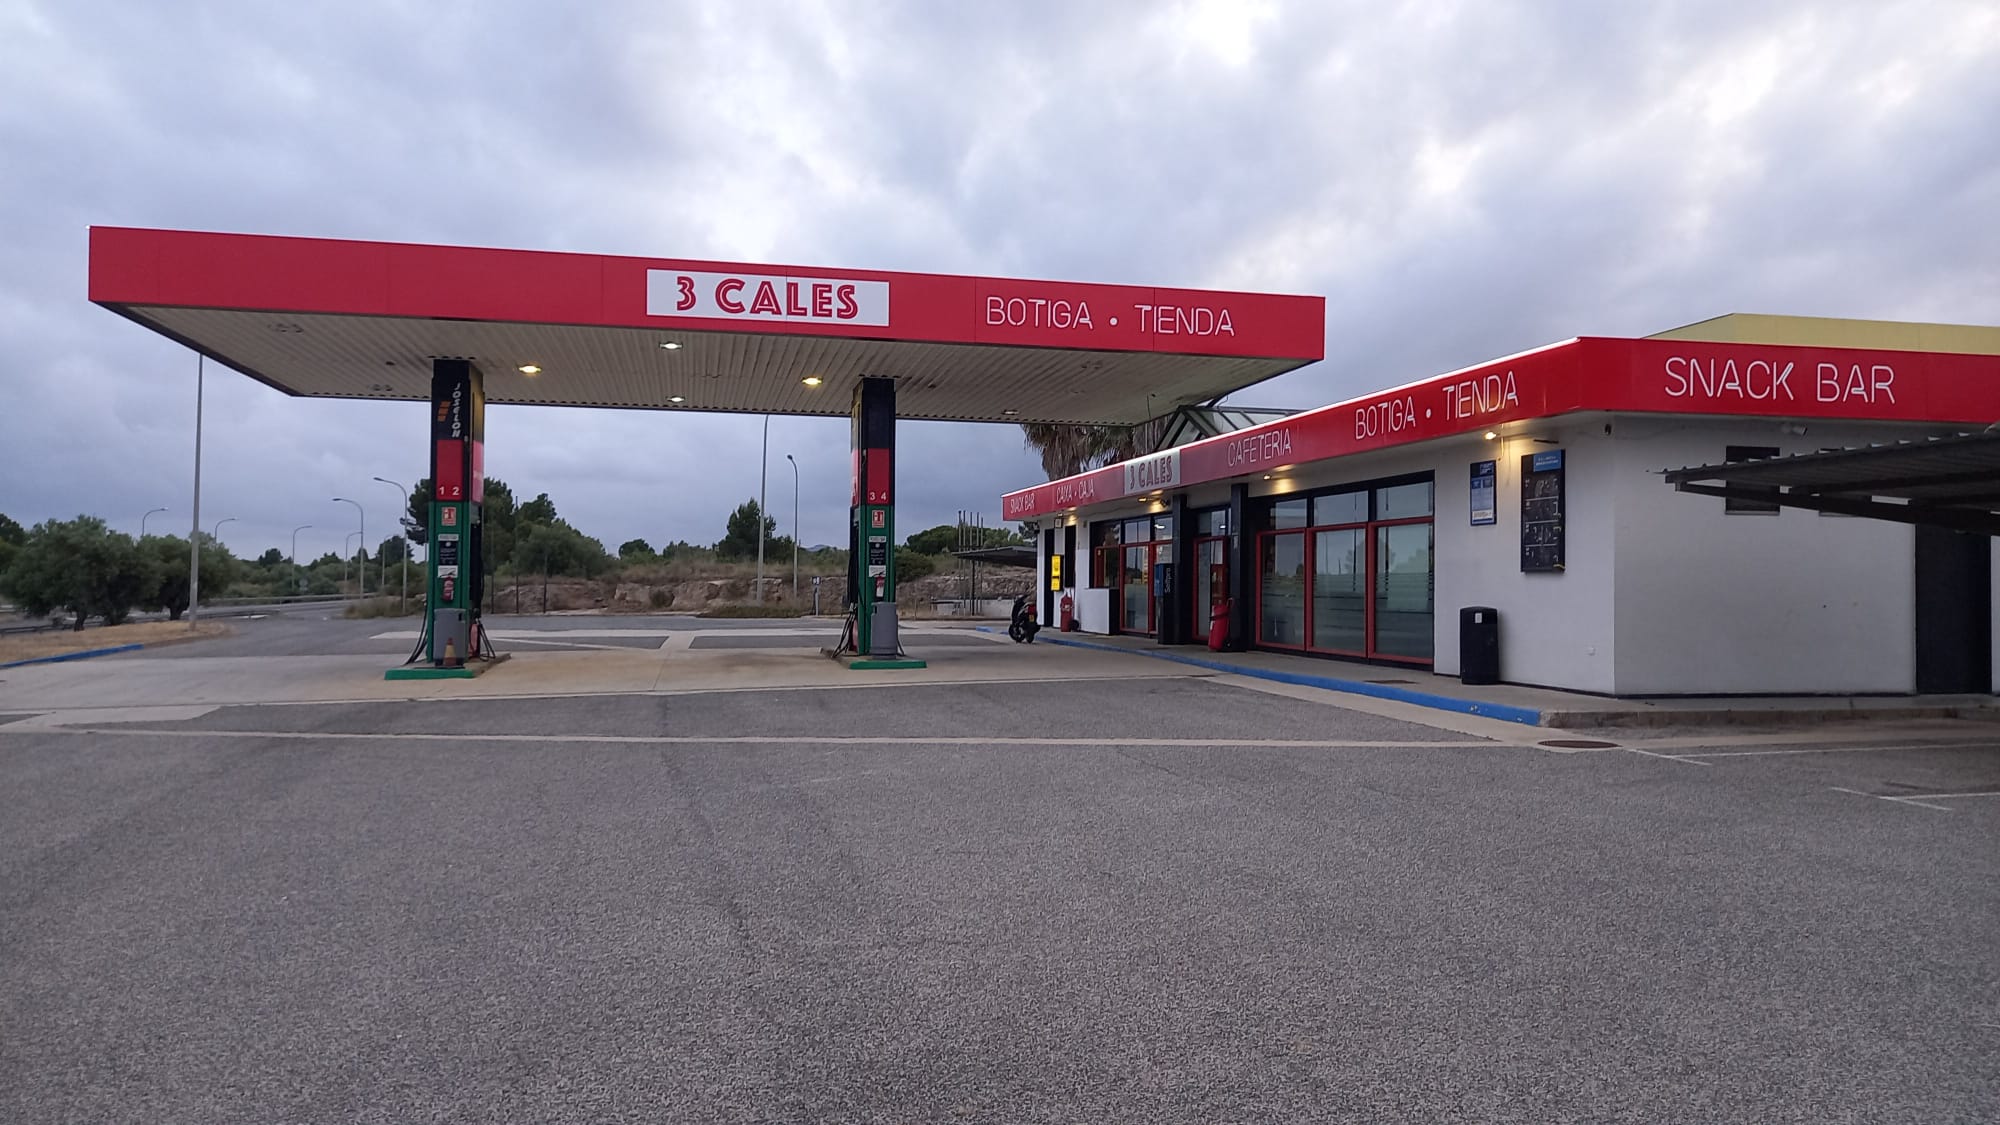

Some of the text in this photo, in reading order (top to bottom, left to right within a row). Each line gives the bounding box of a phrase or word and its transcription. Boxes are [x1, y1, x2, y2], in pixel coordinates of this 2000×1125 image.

[676, 276, 859, 319] 3 CALES
[986, 296, 1235, 336] BOTIGA TIENDA
[1665, 357, 1896, 405] SNACK BAR
[1355, 370, 1519, 440] BOTIGA TIENDA
[1227, 427, 1292, 467] CAFETERIA
[440, 486, 460, 496] 1 2
[1130, 455, 1172, 490] 3 CALES
[869, 491, 887, 501] 3 4
[1010, 492, 1036, 514] SNACK BAR
[1056, 484, 1073, 505] CAIXA
